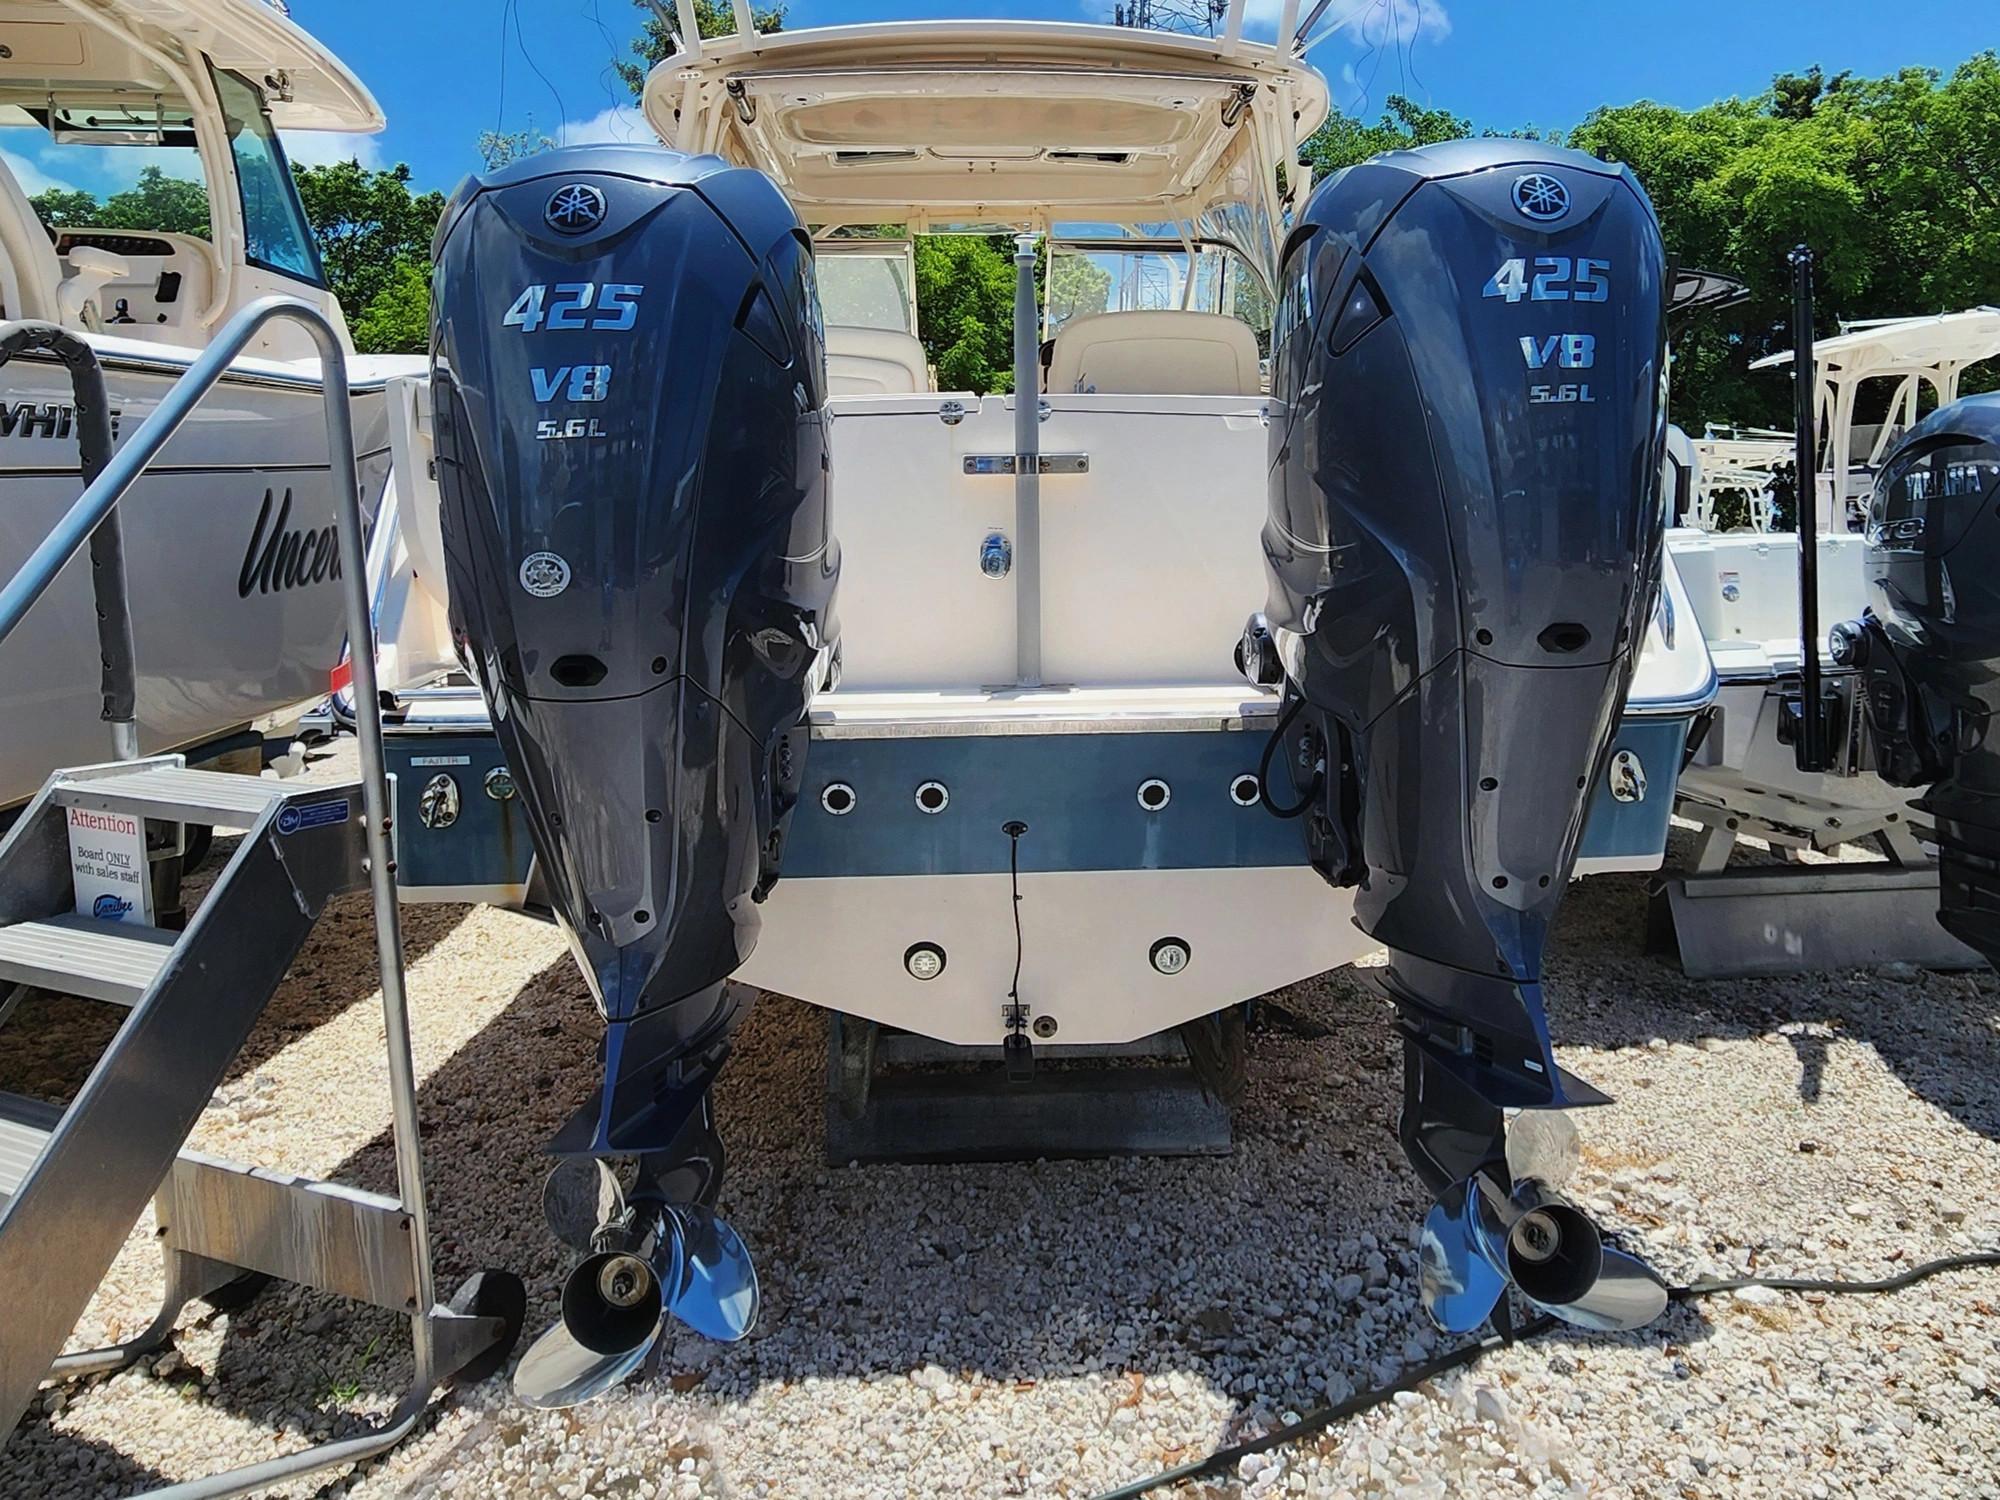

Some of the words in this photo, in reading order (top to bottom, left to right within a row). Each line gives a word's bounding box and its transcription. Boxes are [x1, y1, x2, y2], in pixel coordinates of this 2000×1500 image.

[1482, 257, 1610, 302] 425
[502, 282, 645, 332] 425
[1519, 333, 1596, 369] V8
[529, 364, 612, 402] V8
[1529, 384, 1596, 403] 5.6L
[536, 418, 606, 439] 5.6L
[70, 808, 136, 835] Attention
[78, 846, 104, 862] Board
[106, 851, 131, 868] ONLY
[75, 863, 95, 875] with
[96, 866, 119, 880] sales
[120, 871, 140, 884] staff
